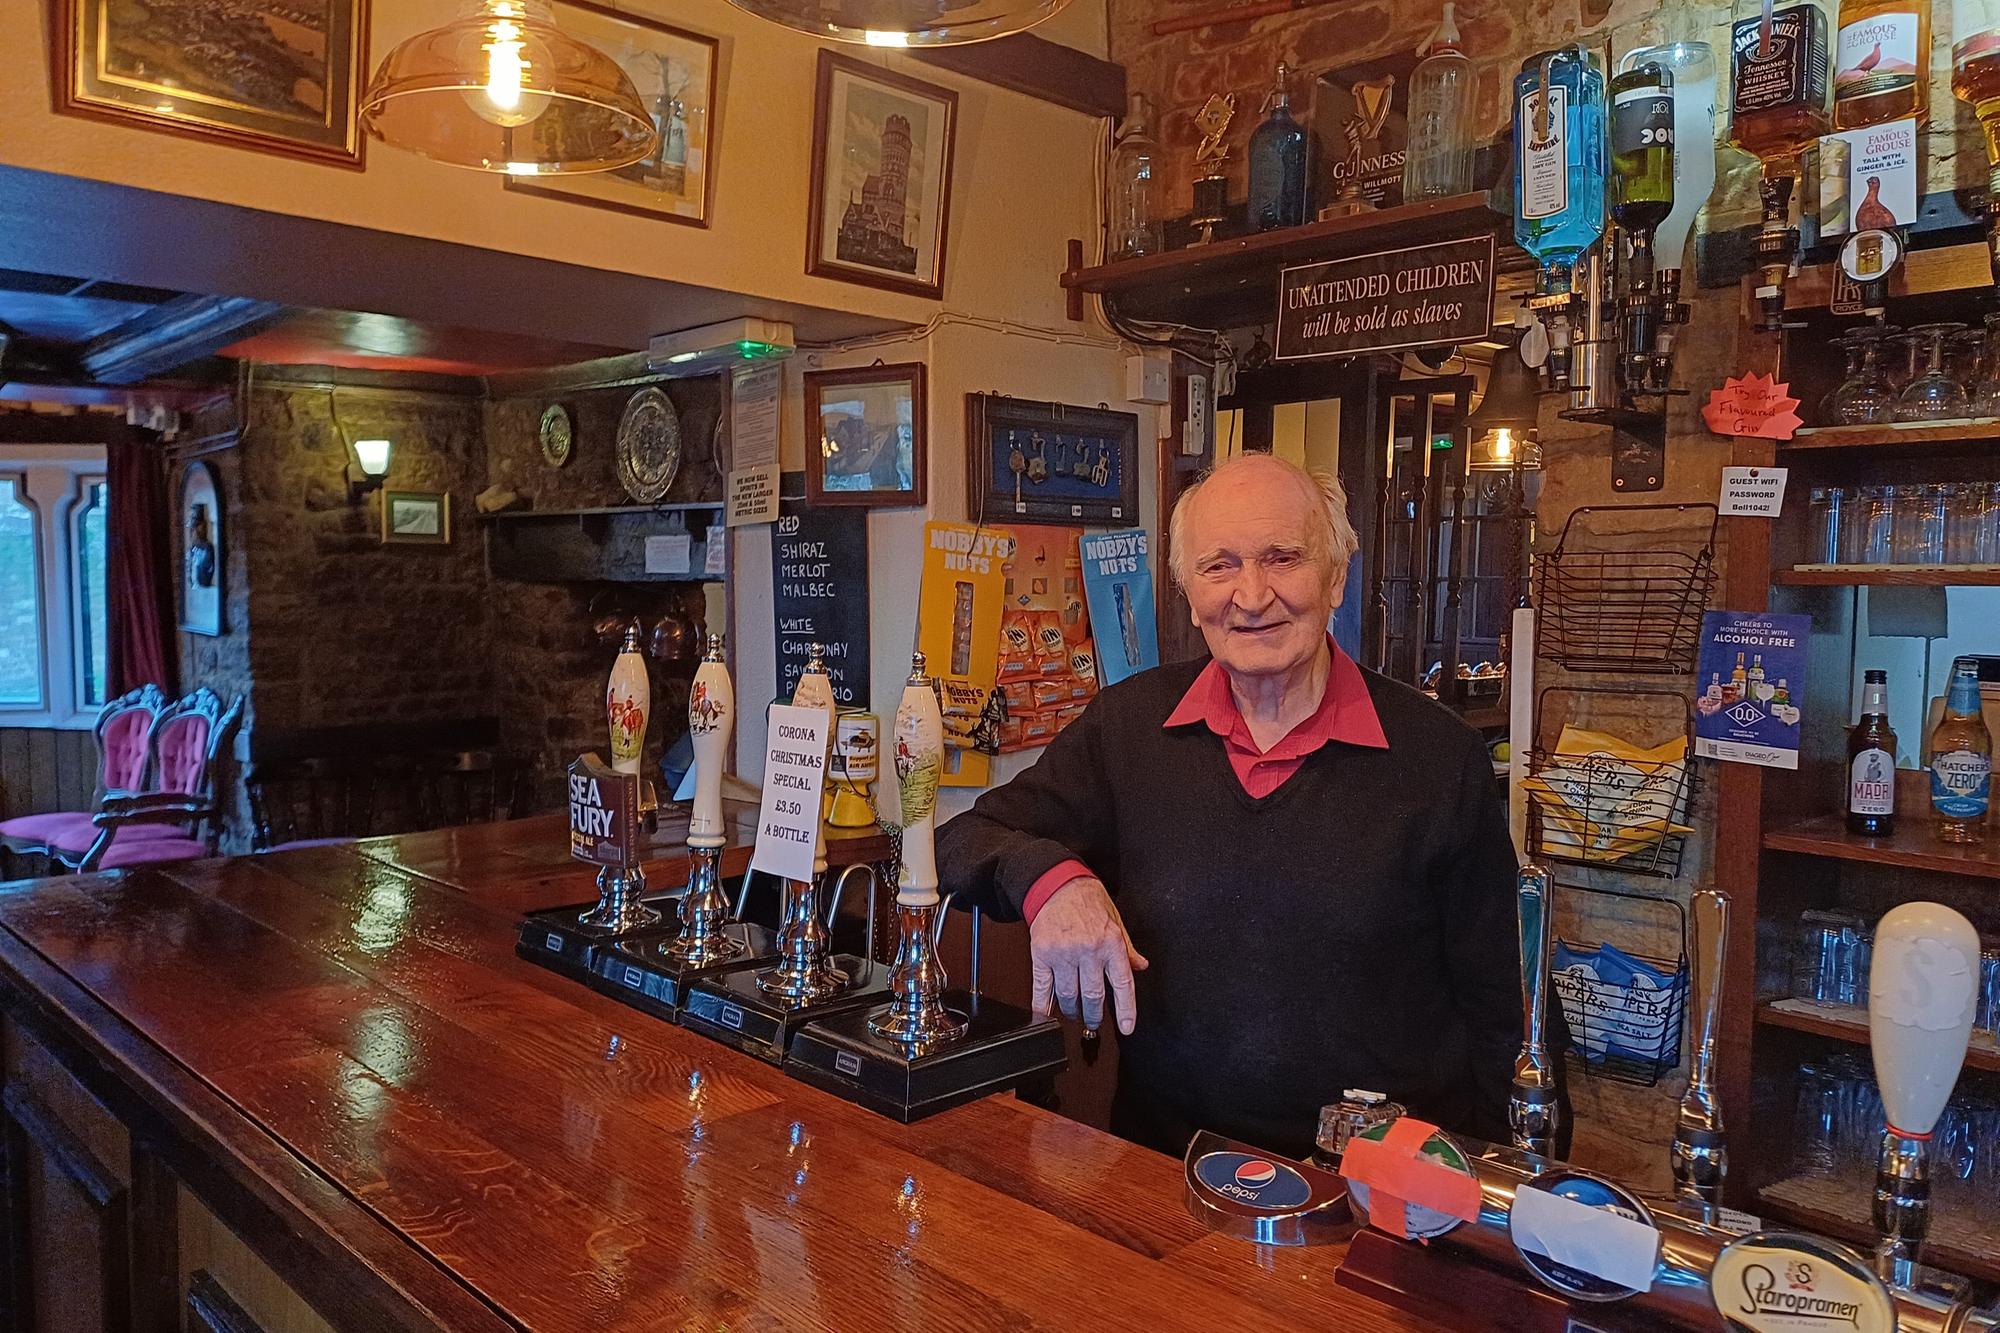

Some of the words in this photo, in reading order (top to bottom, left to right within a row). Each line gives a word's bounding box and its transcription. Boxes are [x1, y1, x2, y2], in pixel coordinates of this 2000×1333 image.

[1735, 28, 1760, 52] JACK
[1771, 22, 1800, 39] ANIEL'S
[1851, 23, 1897, 41] FAMOUS
[1850, 33, 1897, 49] GROUSE
[1744, 70, 1786, 85] WHISKEY
[1868, 130, 1910, 145] FAMOUS
[1865, 139, 1912, 155] GROUSE
[1333, 150, 1406, 179] GUNNESS
[1862, 156, 1880, 164] TALL
[1881, 153, 1901, 161] WITH
[1856, 162, 1885, 173] GINGER
[1363, 175, 1402, 189] WILLMOTT
[1288, 273, 1391, 310] UNATTENDED
[1395, 259, 1485, 295] CHILDREN
[1302, 312, 1332, 339] will
[1334, 310, 1351, 335] be
[1353, 304, 1389, 333] sold
[1391, 306, 1409, 328] as
[1412, 298, 1463, 325] slaves
[1728, 385, 1750, 400] Try
[1719, 399, 1776, 417] Flavoured
[1733, 418, 1761, 433] Gin
[1729, 491, 1775, 499] PASSWORD
[778, 516, 800, 534] RED
[781, 541, 828, 559] SHIRAZ
[930, 529, 1009, 558] NOBBY'S
[1085, 533, 1148, 560] NOBBY'S
[781, 563, 831, 578] MERLOT
[944, 555, 990, 575] NUTS
[1099, 556, 1138, 576] NUTS
[782, 583, 836, 598] MALBEC
[780, 617, 815, 631] WHITE
[1720, 626, 1738, 634] MORE
[1740, 627, 1769, 635] CHOICE
[1734, 620, 1761, 628] CHEERS
[1713, 634, 1765, 646] ALCOHOL
[1768, 638, 1796, 647] FREE
[953, 695, 978, 704] NUTS
[778, 725, 816, 742] CORONA
[770, 749, 823, 769] CHRISTMAS
[570, 773, 602, 807] SEA
[772, 773, 811, 791] SPECIAL
[775, 799, 801, 815] £3.50
[1861, 805, 1886, 813] ZERO
[764, 823, 771, 836] A
[772, 827, 810, 844] BOTTLE
[1631, 1026, 1652, 1039] SALT
[1220, 1182, 1261, 1201] pepsi
[1740, 1263, 1861, 1331] Staropramen
